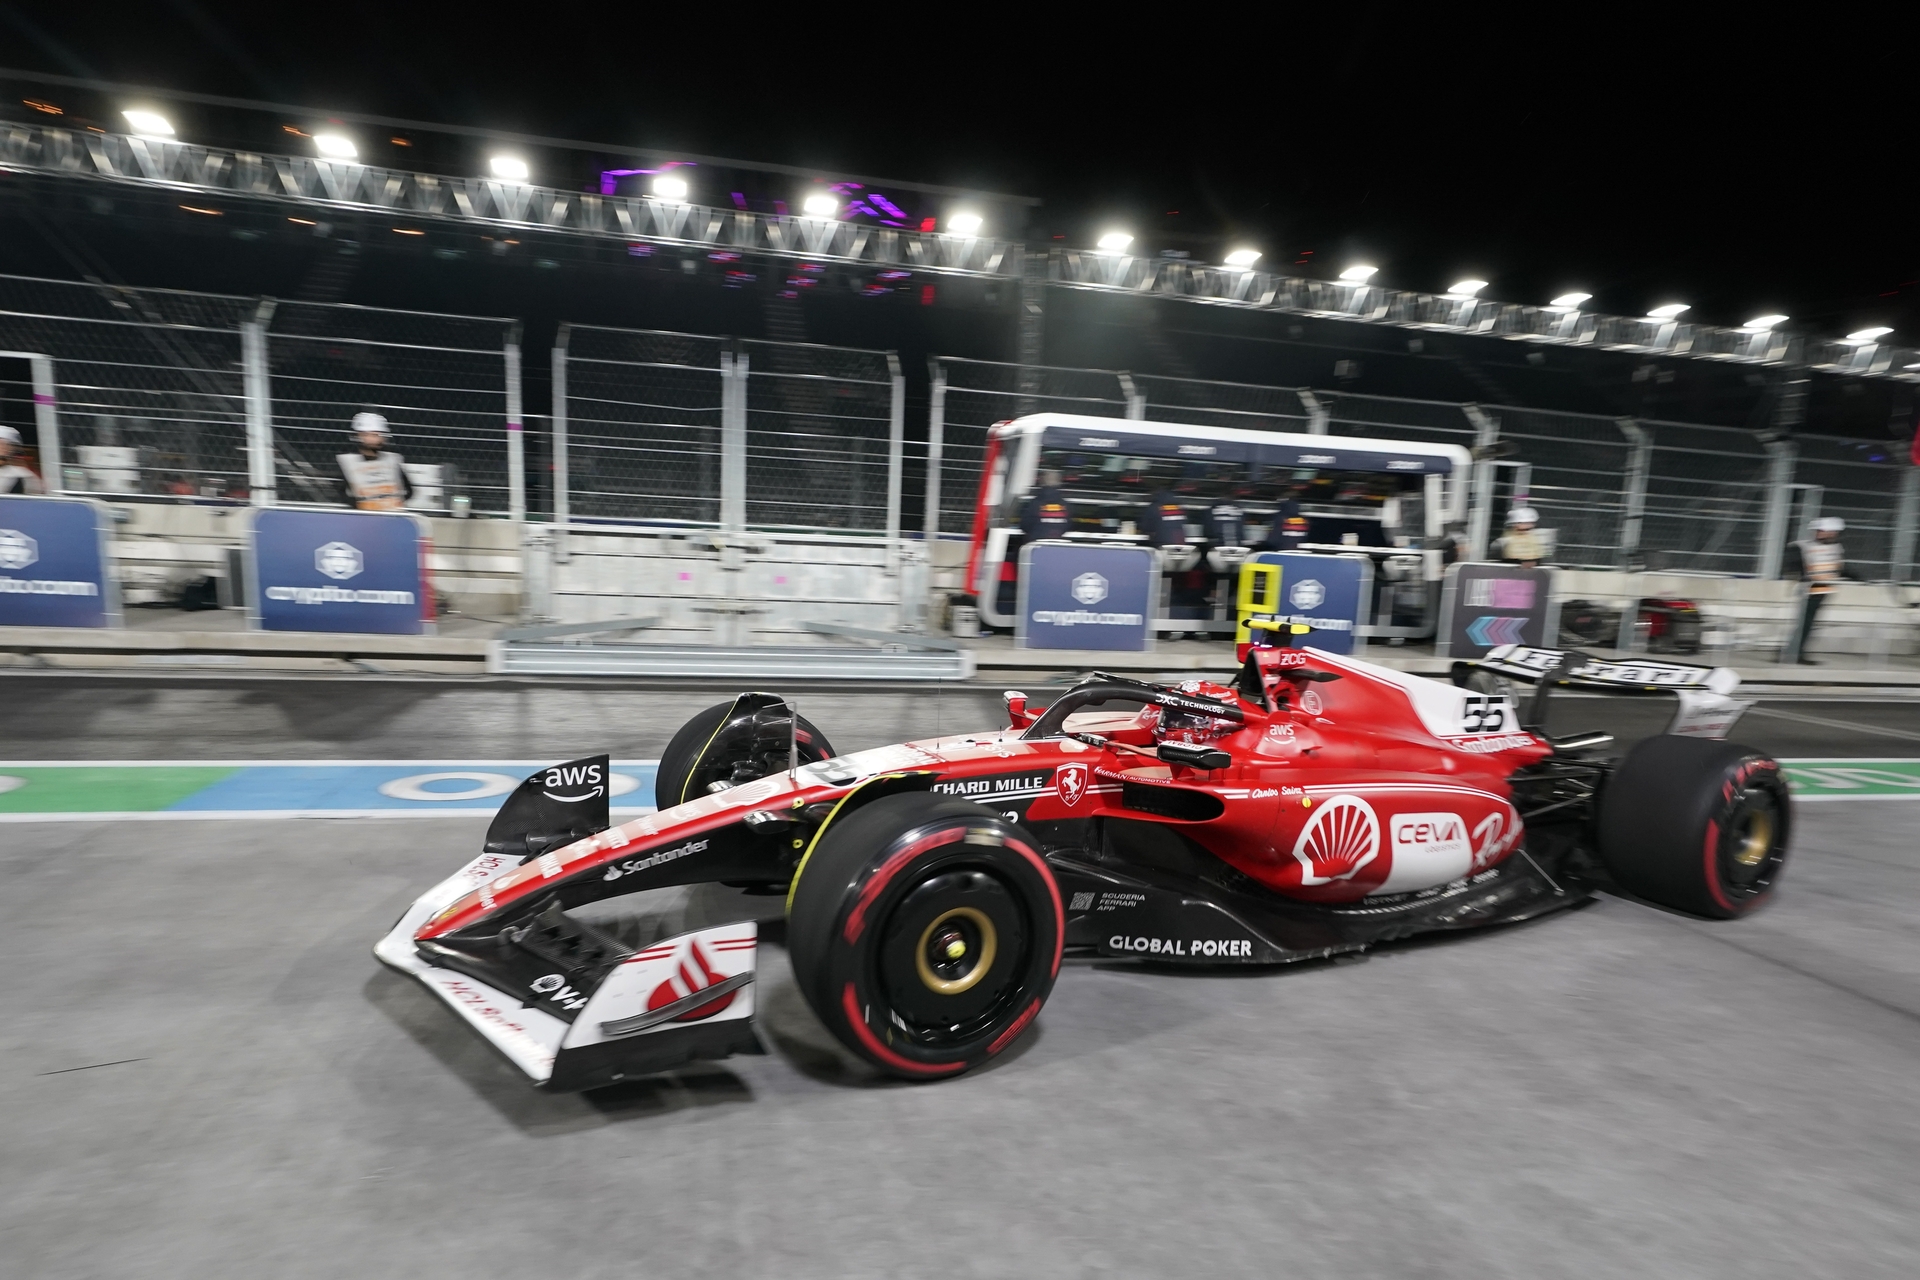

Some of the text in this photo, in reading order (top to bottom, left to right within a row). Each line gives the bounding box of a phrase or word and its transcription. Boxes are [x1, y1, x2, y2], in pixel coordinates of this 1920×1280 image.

[1280, 653, 1306, 666] ZCG
[1180, 700, 1226, 715] TECHNOLOGY
[1464, 696, 1504, 733] 55
[1269, 724, 1295, 736] aws
[544, 763, 602, 788] aws
[1094, 765, 1171, 785] HARMAN AUTOMOTIVE
[930, 776, 1043, 795] CHARD MILLE
[1251, 787, 1279, 799] Carlos
[621, 838, 710, 876] Santander
[1098, 899, 1137, 908] FERRARI
[1101, 892, 1146, 902] SCUDERIA
[1108, 935, 1252, 957] GLOBAL POKER
